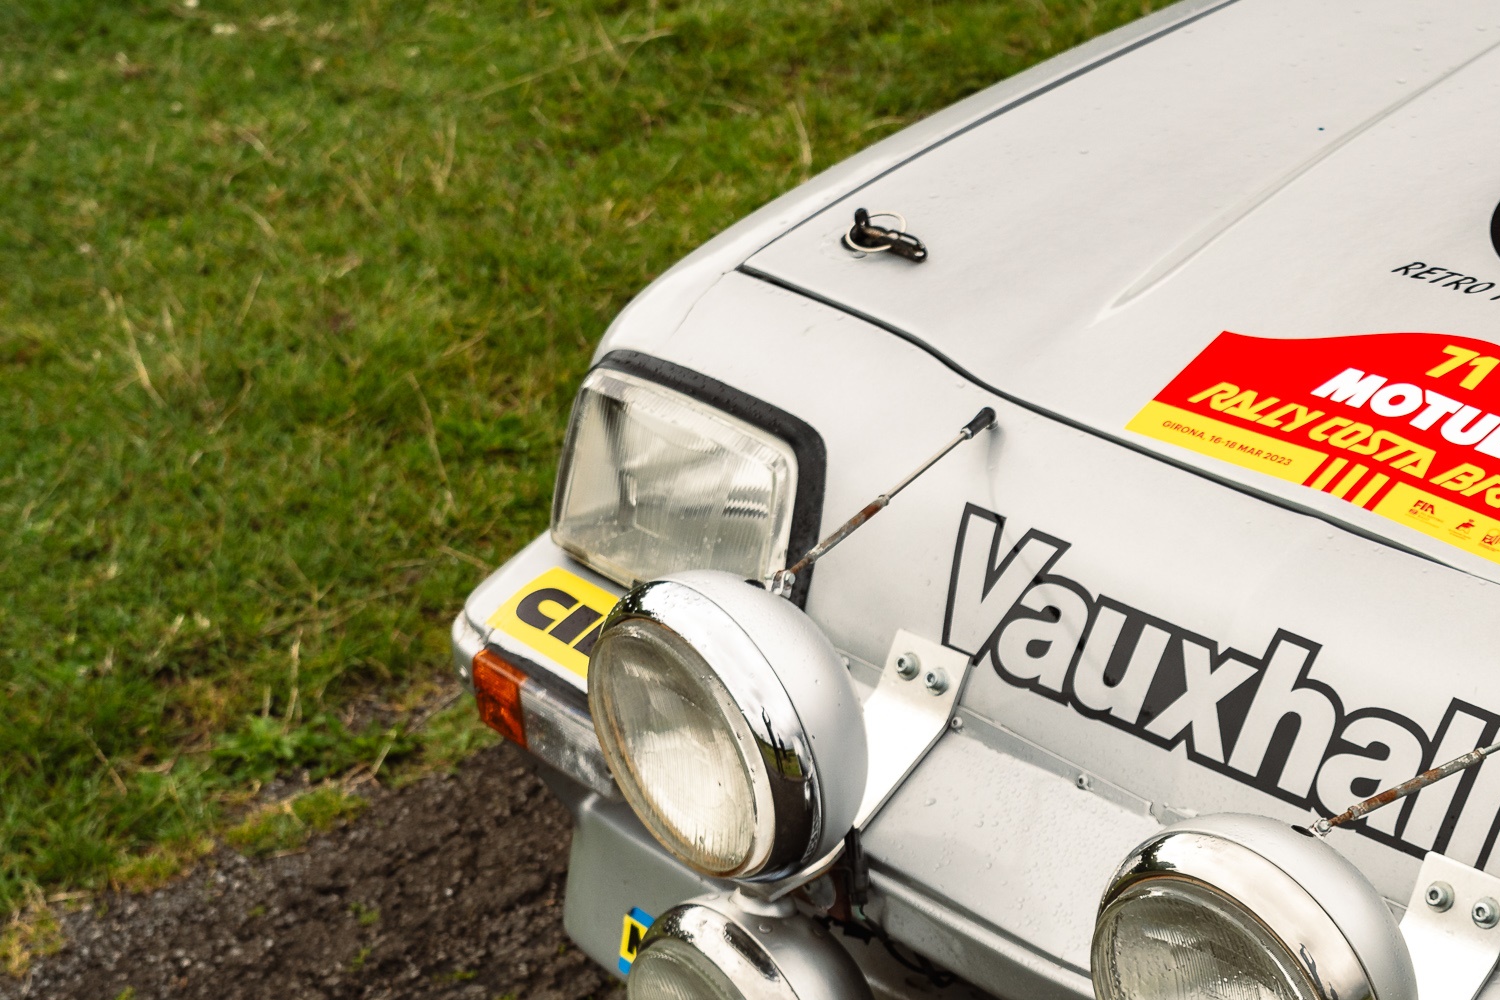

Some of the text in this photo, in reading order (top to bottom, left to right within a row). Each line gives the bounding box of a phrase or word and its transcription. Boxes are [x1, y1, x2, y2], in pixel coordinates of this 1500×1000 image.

[1391, 260, 1496, 295] RETRO
[1162, 420, 1293, 466] GIRONA, 16-18 MAR 2023
[1187, 381, 1327, 434] RALLY
[1308, 416, 1438, 485] COSTA
